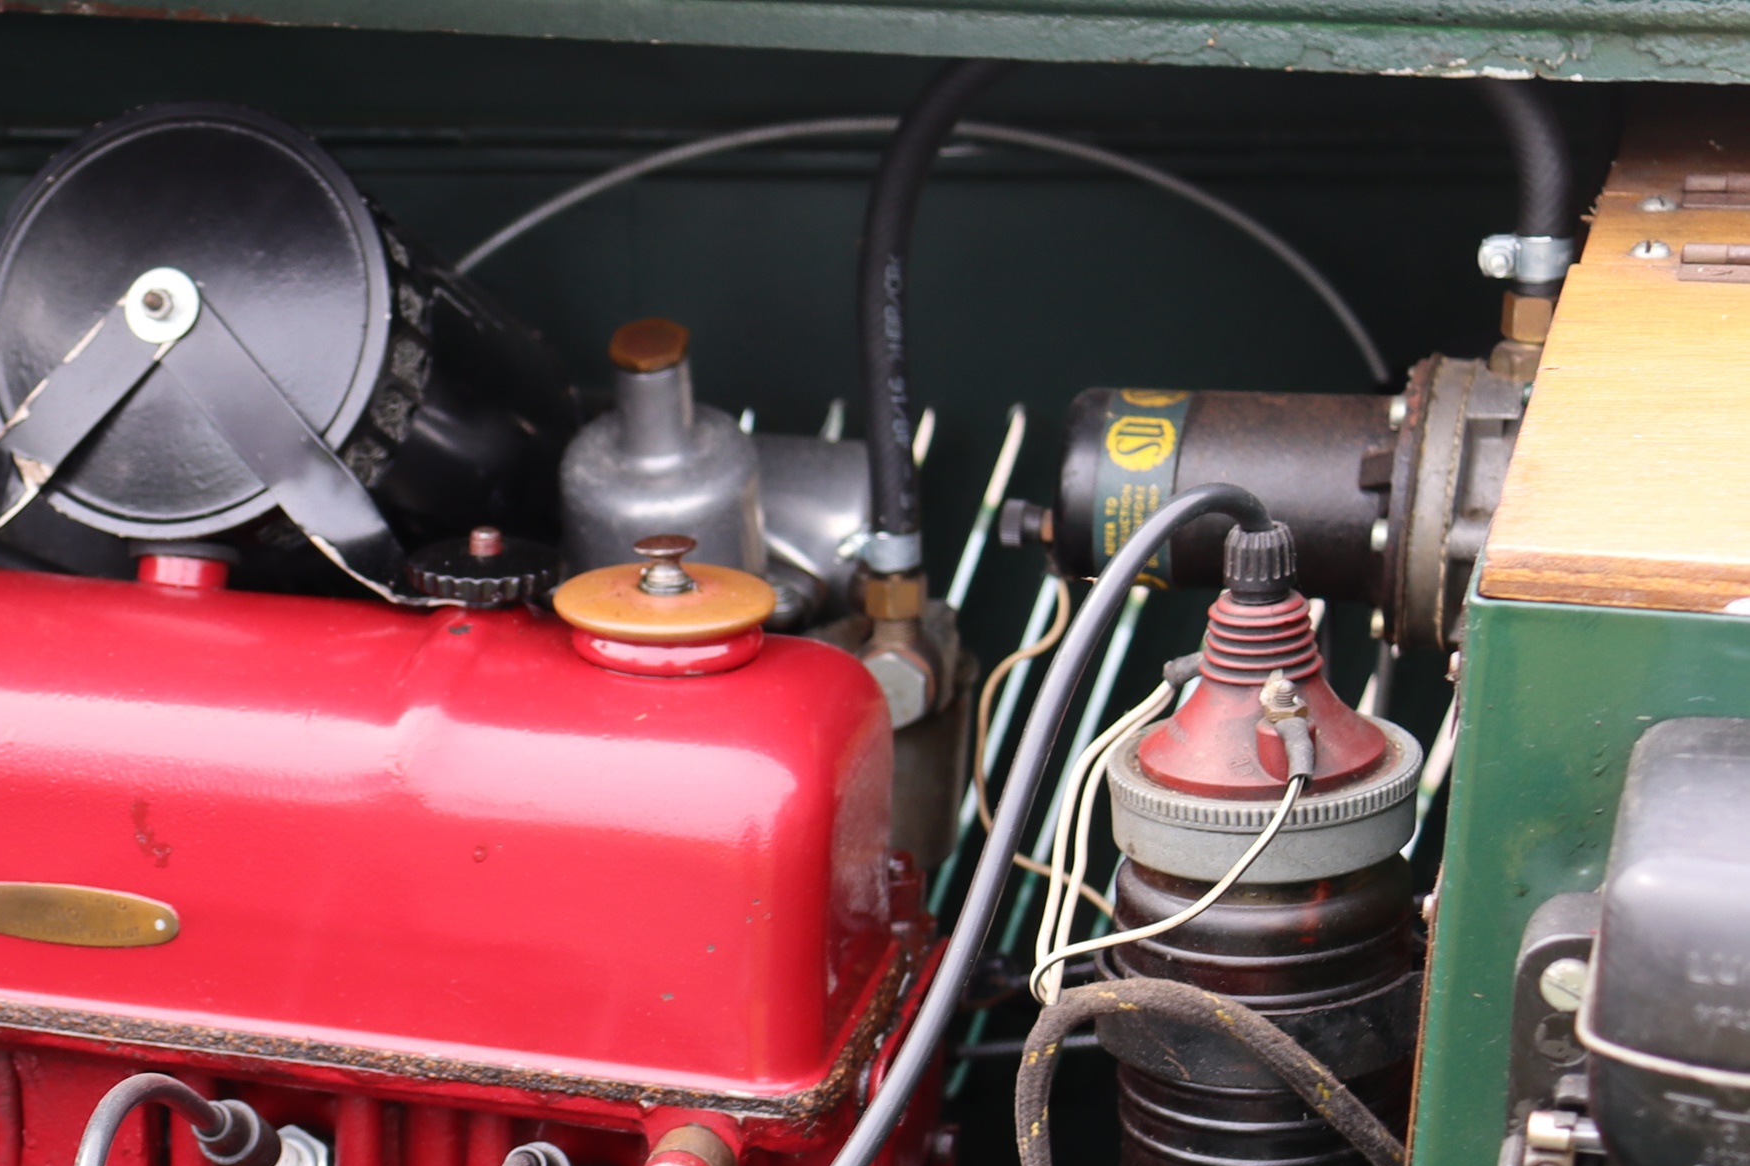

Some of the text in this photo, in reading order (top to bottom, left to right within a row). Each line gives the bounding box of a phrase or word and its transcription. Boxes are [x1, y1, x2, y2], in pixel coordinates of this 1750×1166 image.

[1116, 421, 1165, 457] SU
[1105, 497, 1118, 516] TO
[1120, 484, 1132, 543] RUCTION
[1134, 485, 1146, 526] EFORE
